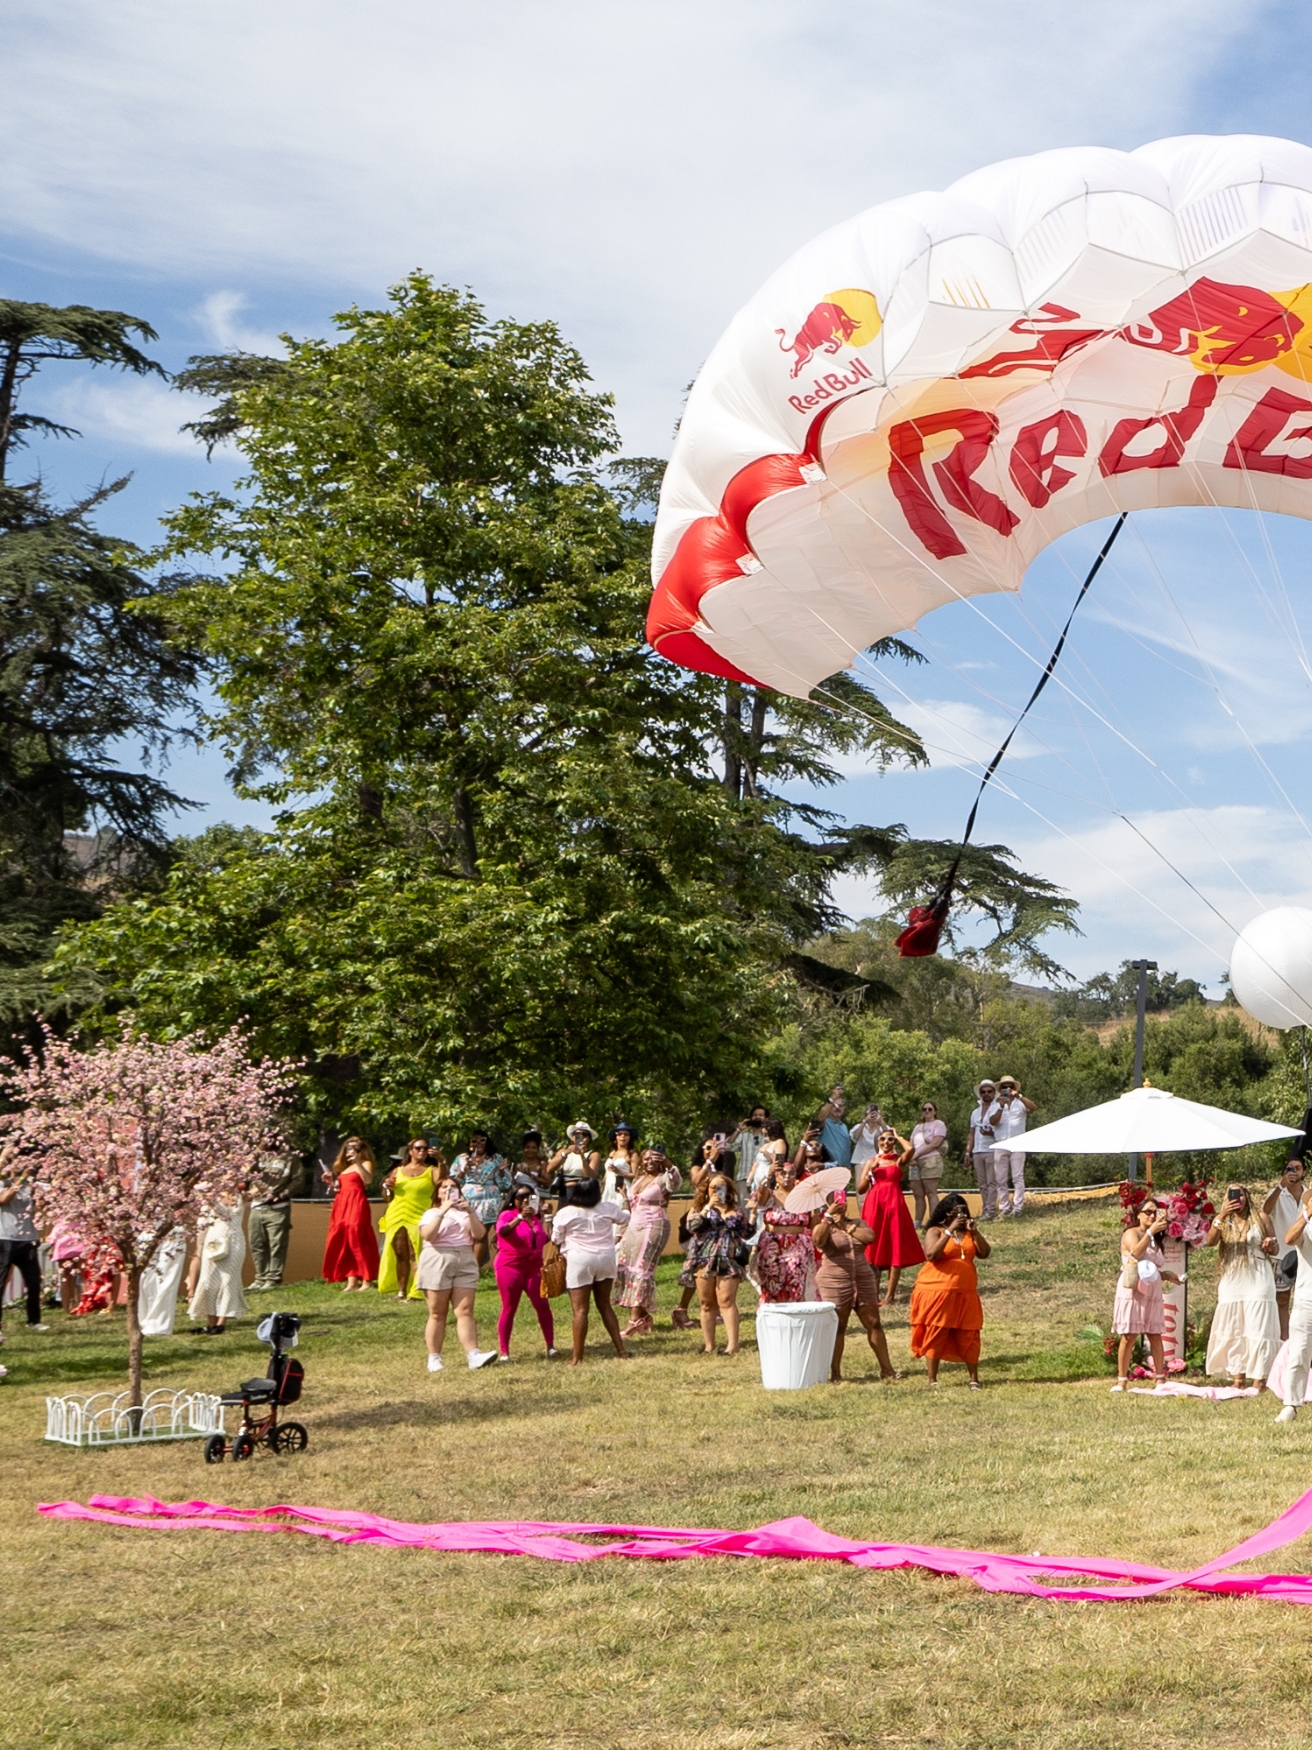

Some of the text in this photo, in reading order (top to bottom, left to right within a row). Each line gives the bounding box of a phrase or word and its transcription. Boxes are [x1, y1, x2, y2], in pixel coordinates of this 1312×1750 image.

[788, 358, 873, 415] Red Bull
[887, 375, 1224, 560] Red
